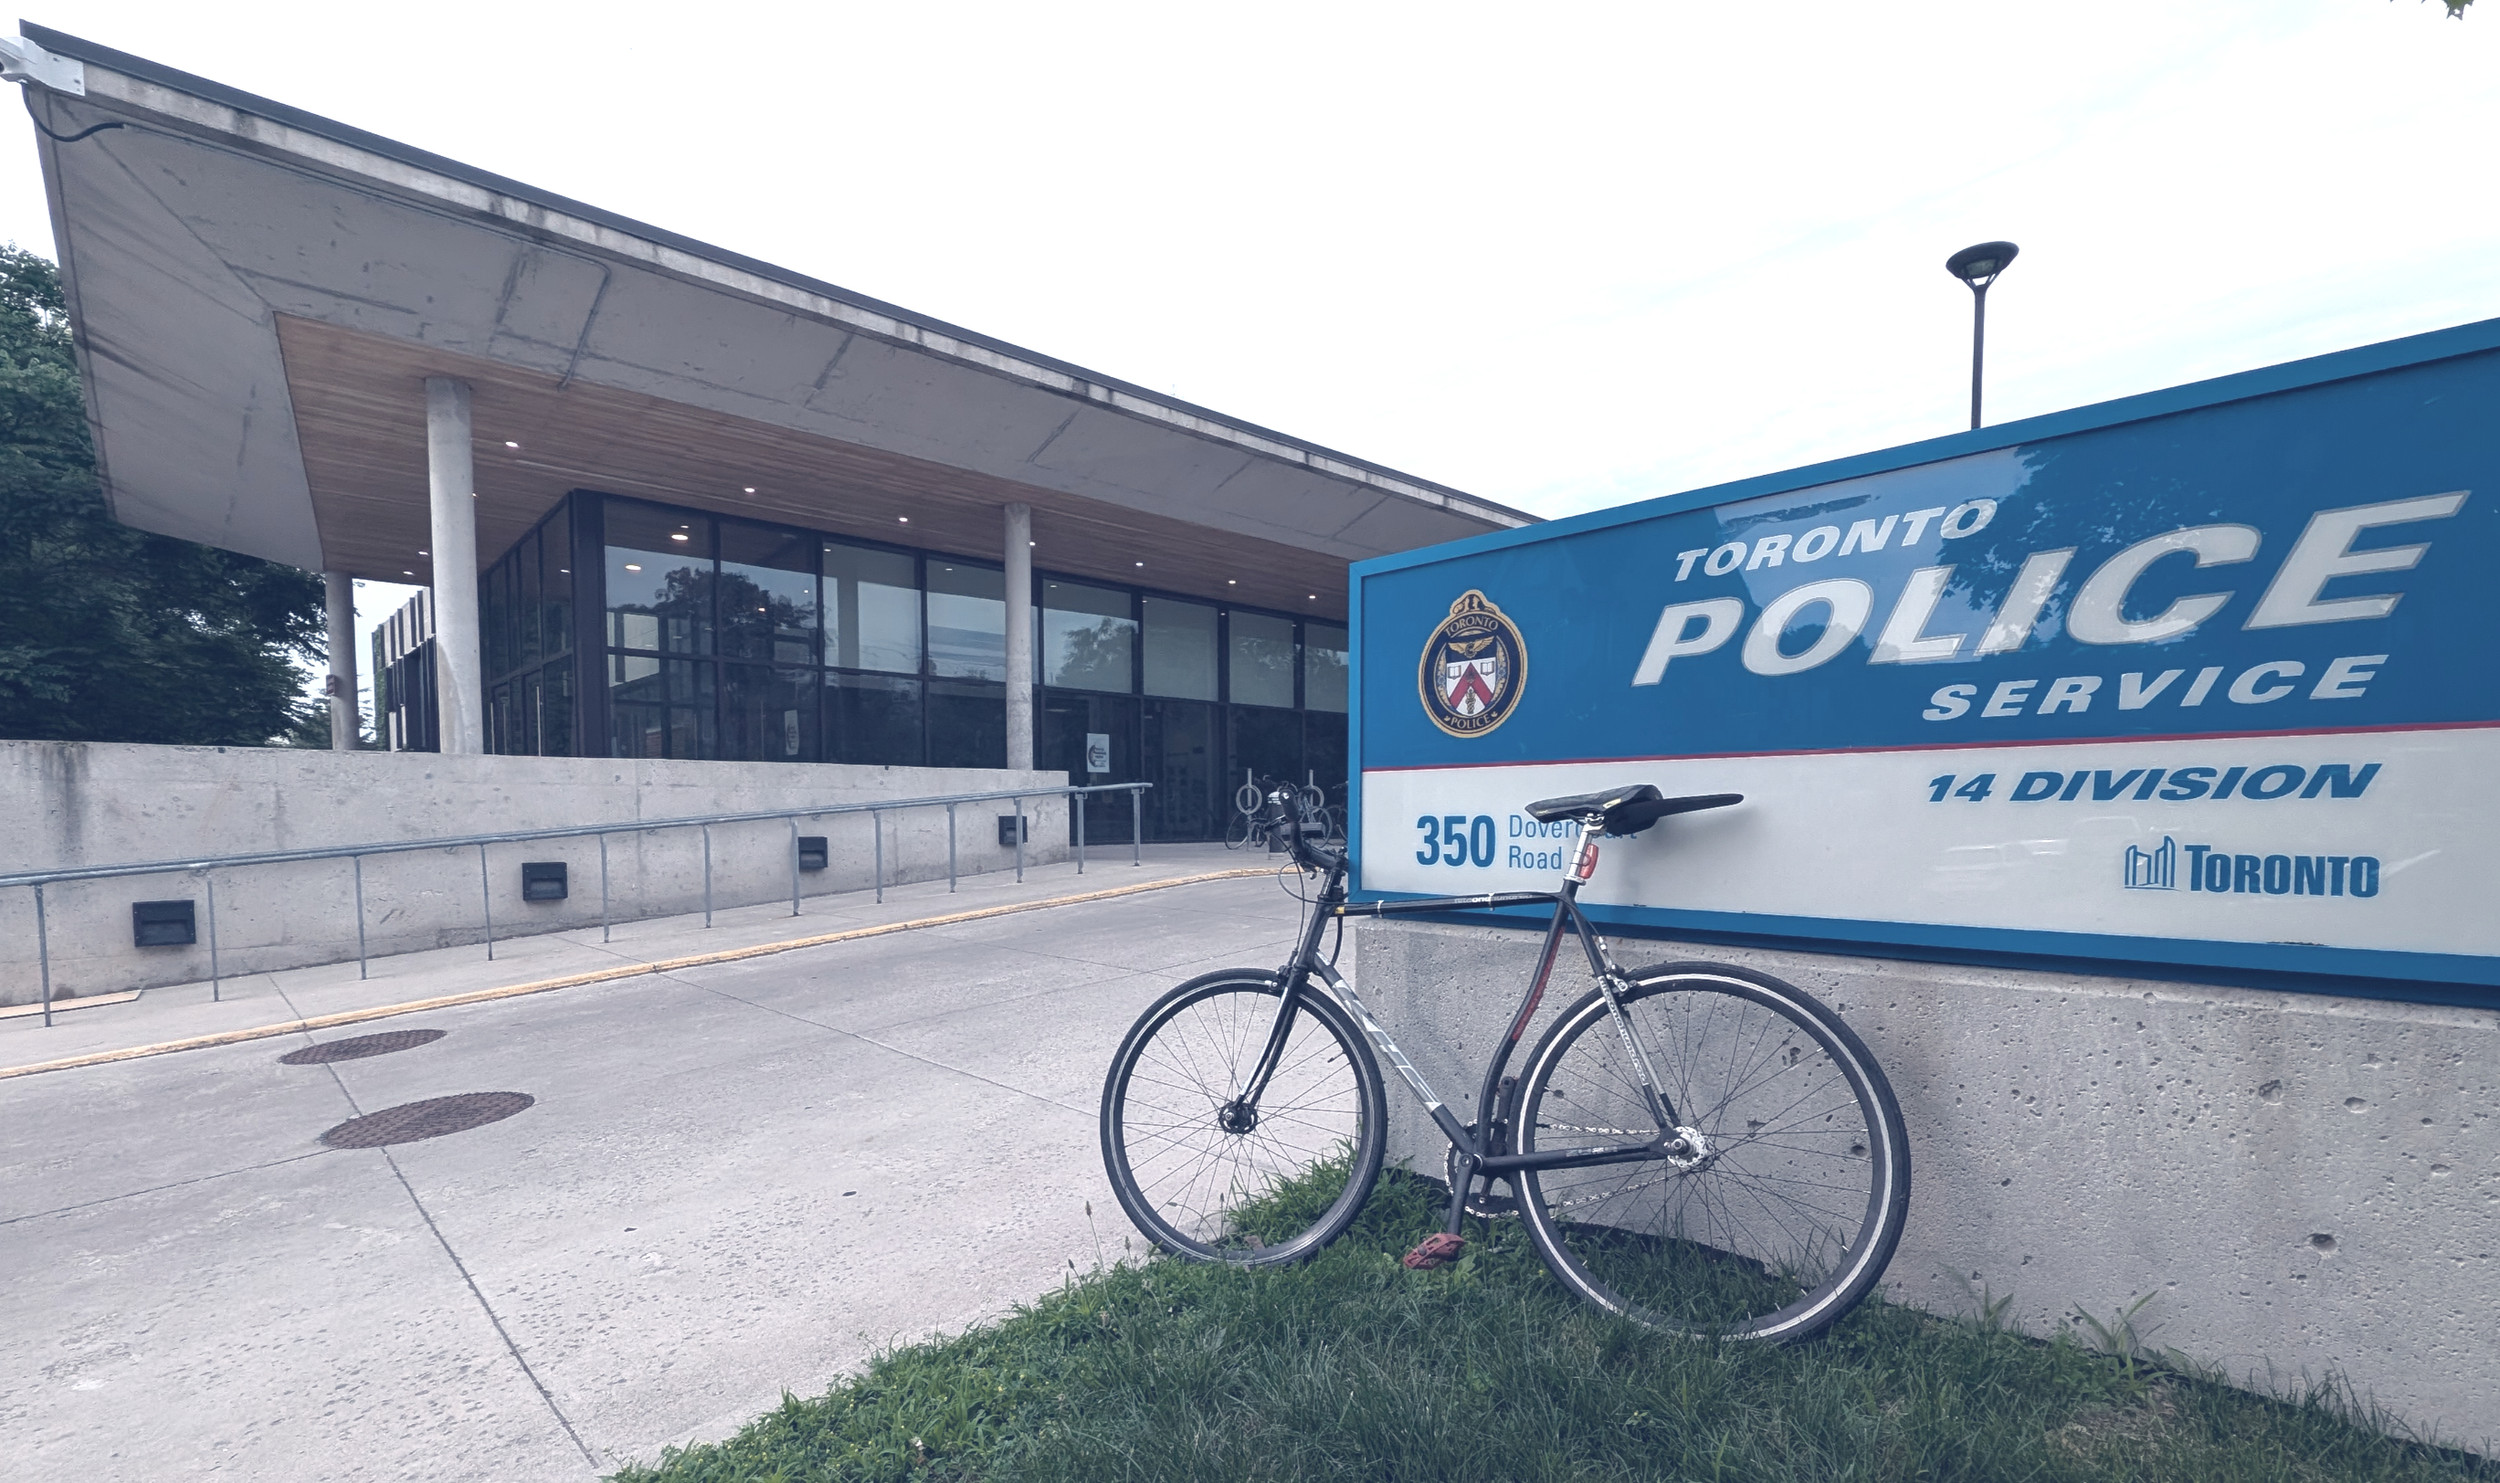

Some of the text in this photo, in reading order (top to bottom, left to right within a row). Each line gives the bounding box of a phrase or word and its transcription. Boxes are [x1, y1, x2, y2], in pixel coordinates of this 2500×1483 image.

[1674, 498, 1998, 582] TORONTO
[1631, 490, 2472, 687] POLICE
[1444, 616, 1499, 637] TORONTO
[1923, 654, 2389, 723] SERVICE
[1450, 714, 1492, 730] POLICE
[1928, 763, 2382, 802] 14 DIVISION
[1416, 814, 1496, 867] 350
[1509, 814, 1638, 839] Dover
[1508, 845, 1562, 870] Road
[2184, 843, 2381, 898] TORONTO
